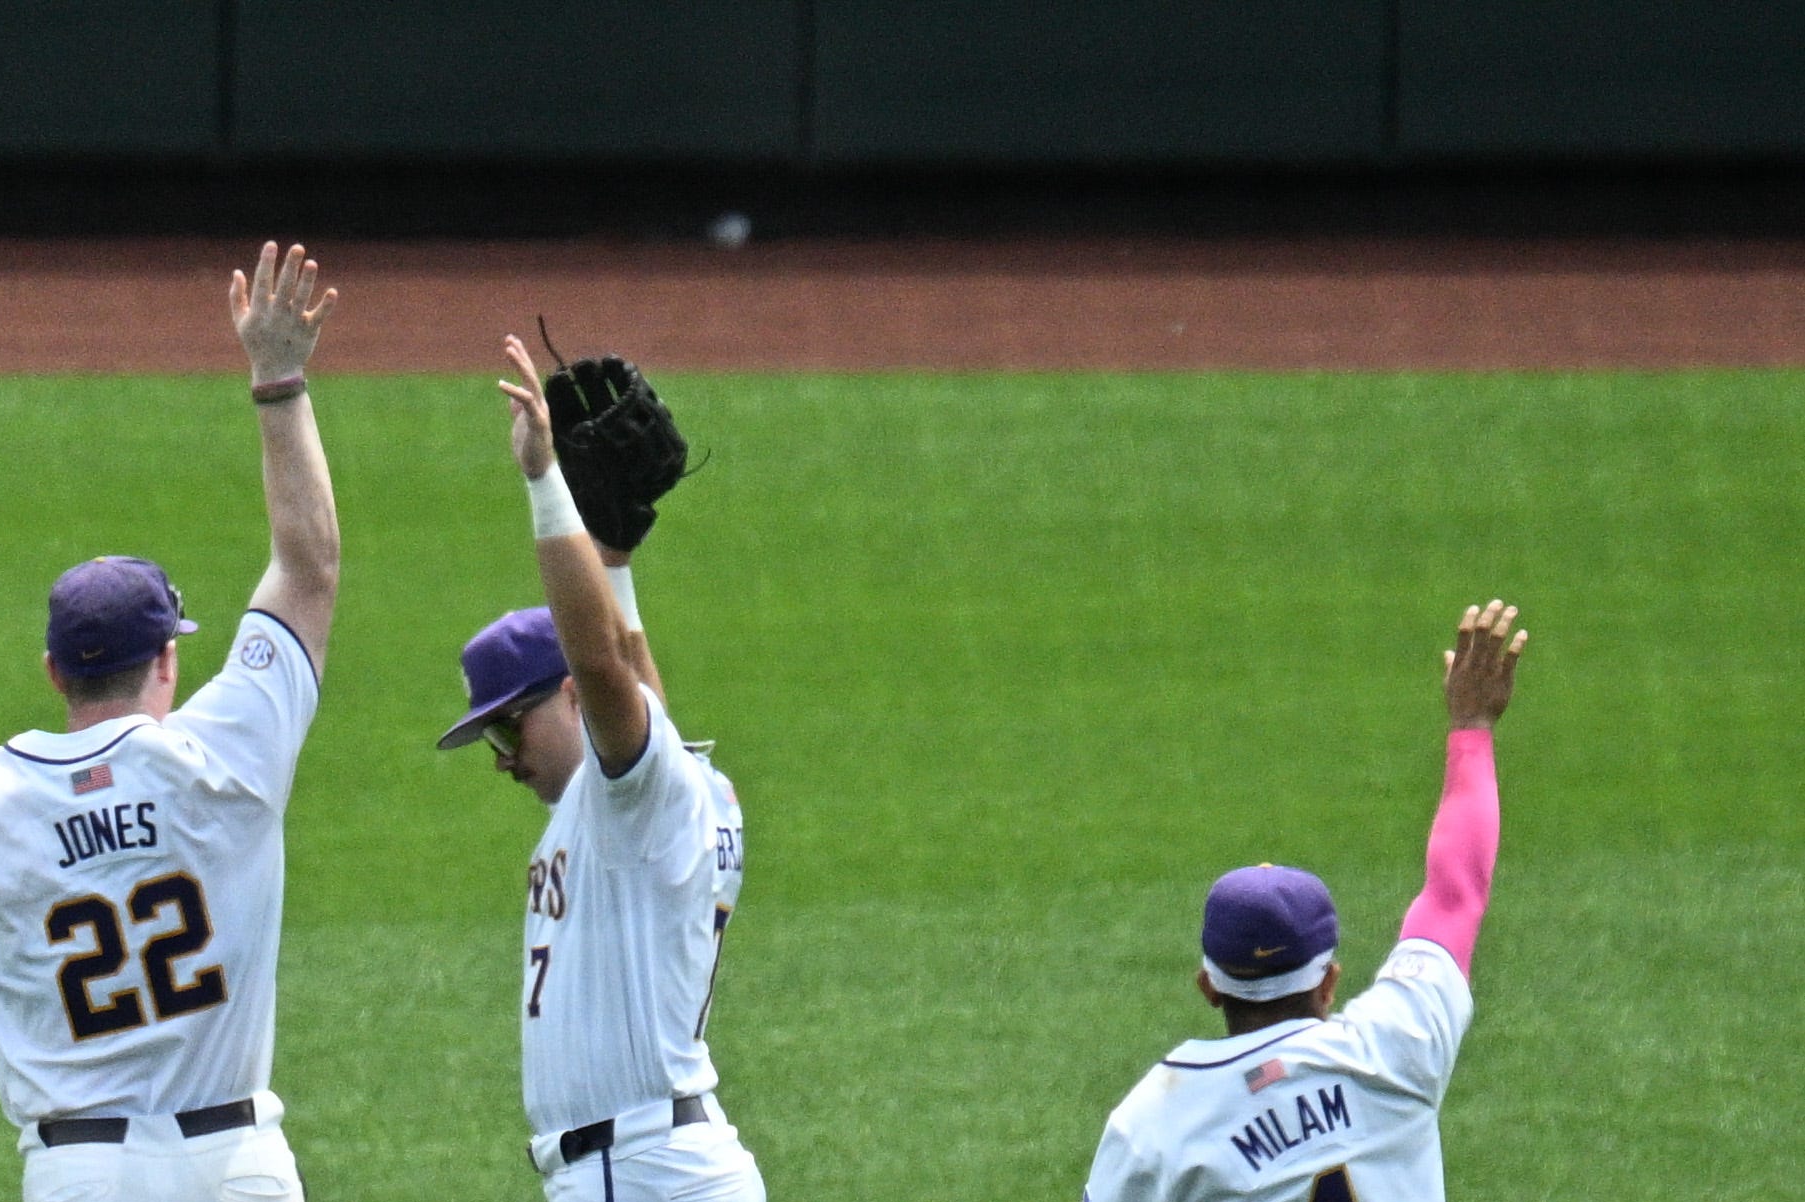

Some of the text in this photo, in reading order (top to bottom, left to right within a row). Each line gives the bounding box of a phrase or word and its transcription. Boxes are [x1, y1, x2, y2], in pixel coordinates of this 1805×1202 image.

[54, 801, 157, 868] JONES
[44, 869, 229, 1043] 22
[528, 945, 551, 1018] 7
[1230, 1083, 1352, 1173] MILAM
